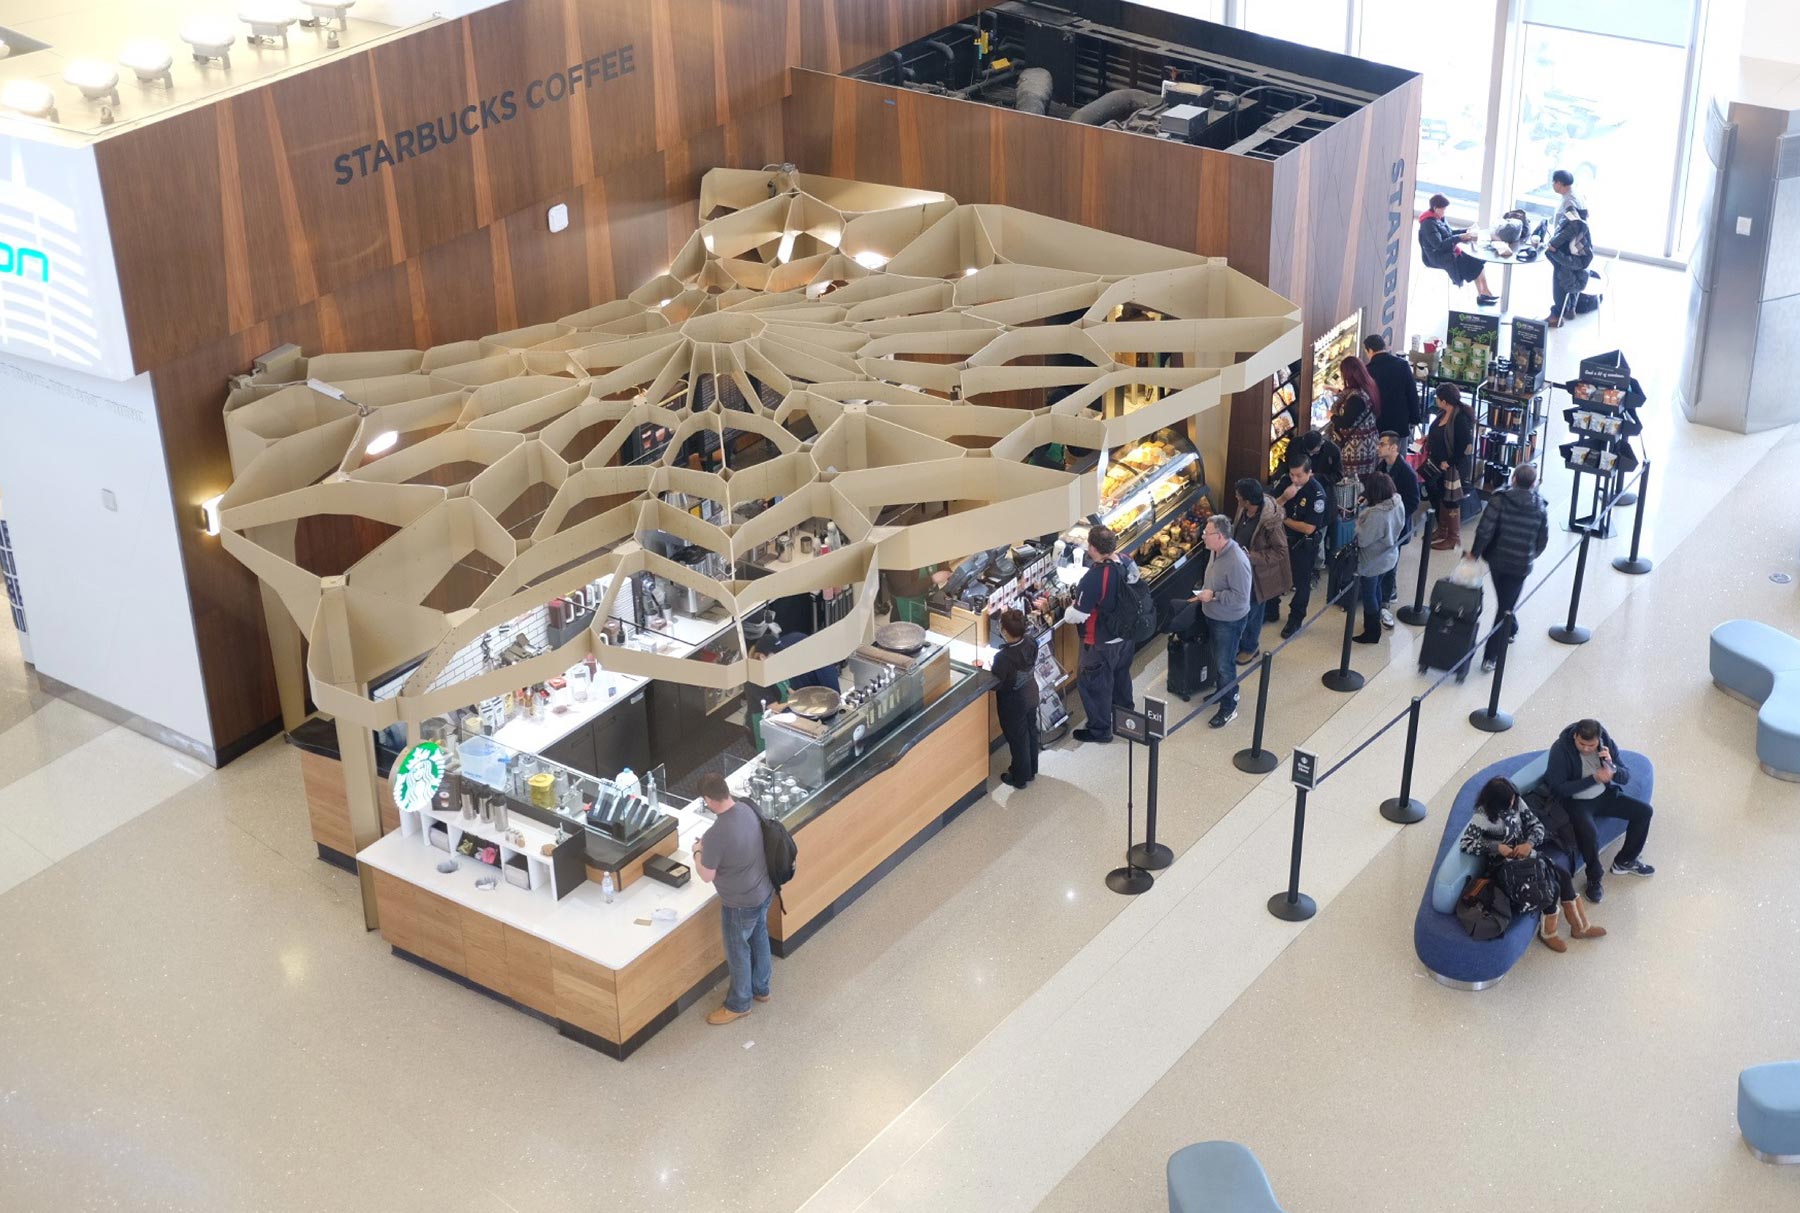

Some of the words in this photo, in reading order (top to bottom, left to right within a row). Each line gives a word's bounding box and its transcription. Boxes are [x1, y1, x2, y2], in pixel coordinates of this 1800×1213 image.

[333, 90, 518, 186] STARBUCKS
[525, 44, 636, 110] COFFEE
[1382, 158, 1405, 350] STARBUC
[1147, 710, 1162, 723] Exit
